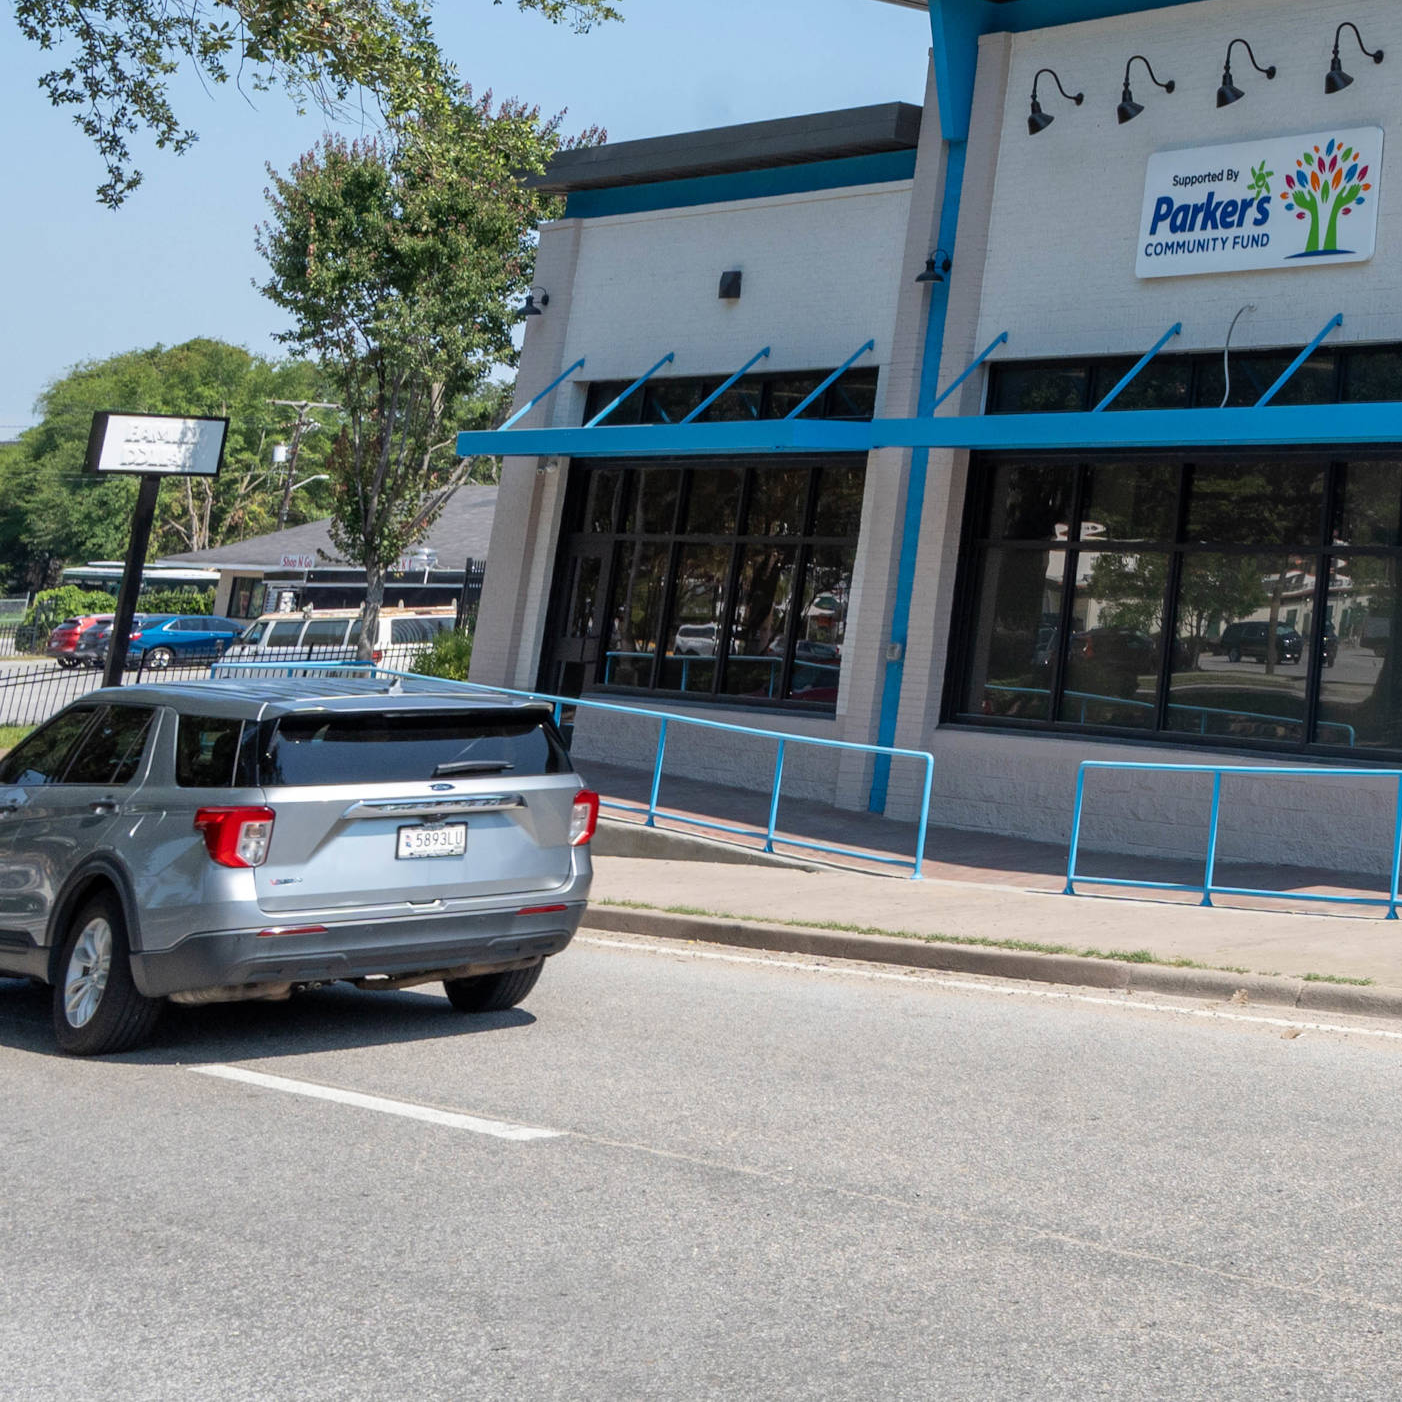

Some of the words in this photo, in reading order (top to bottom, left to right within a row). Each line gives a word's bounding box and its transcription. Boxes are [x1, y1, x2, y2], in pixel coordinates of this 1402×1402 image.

[1172, 169, 1224, 188] Supported
[1226, 168, 1240, 182] By
[1144, 236, 1230, 257] COMMUNITY
[1231, 233, 1271, 249] FUND
[415, 830, 463, 848] 5893LU
